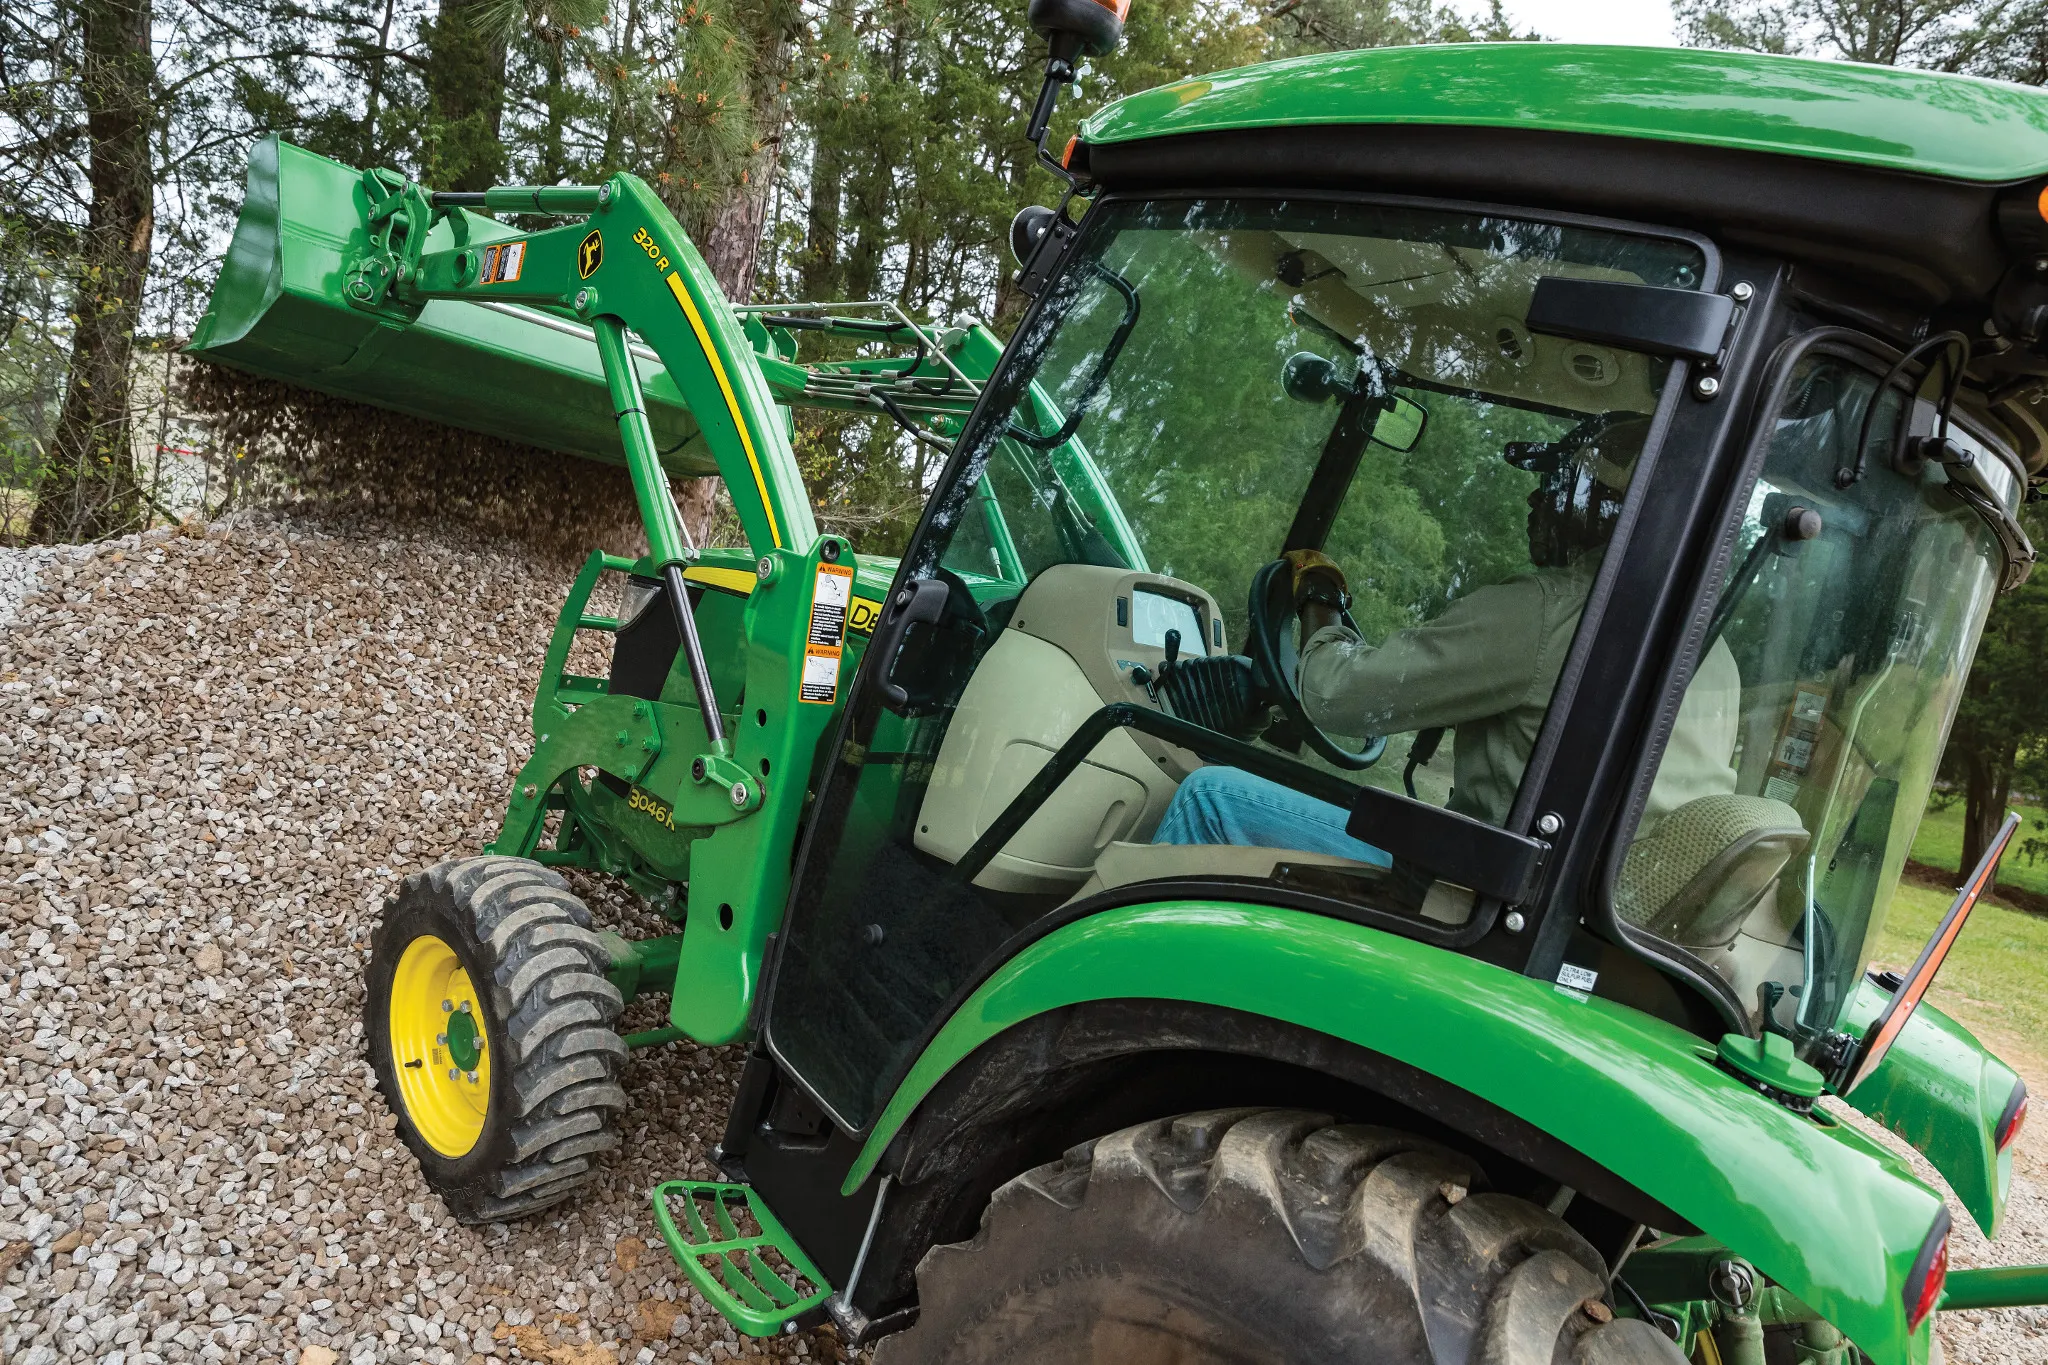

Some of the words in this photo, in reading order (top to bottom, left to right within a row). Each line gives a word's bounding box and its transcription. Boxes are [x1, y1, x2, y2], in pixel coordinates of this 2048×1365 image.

[827, 566, 852, 576] WARNING
[815, 648, 840, 657] WARNING
[1562, 965, 1580, 974] ULTRA
[1558, 976, 1572, 984] ONLY
